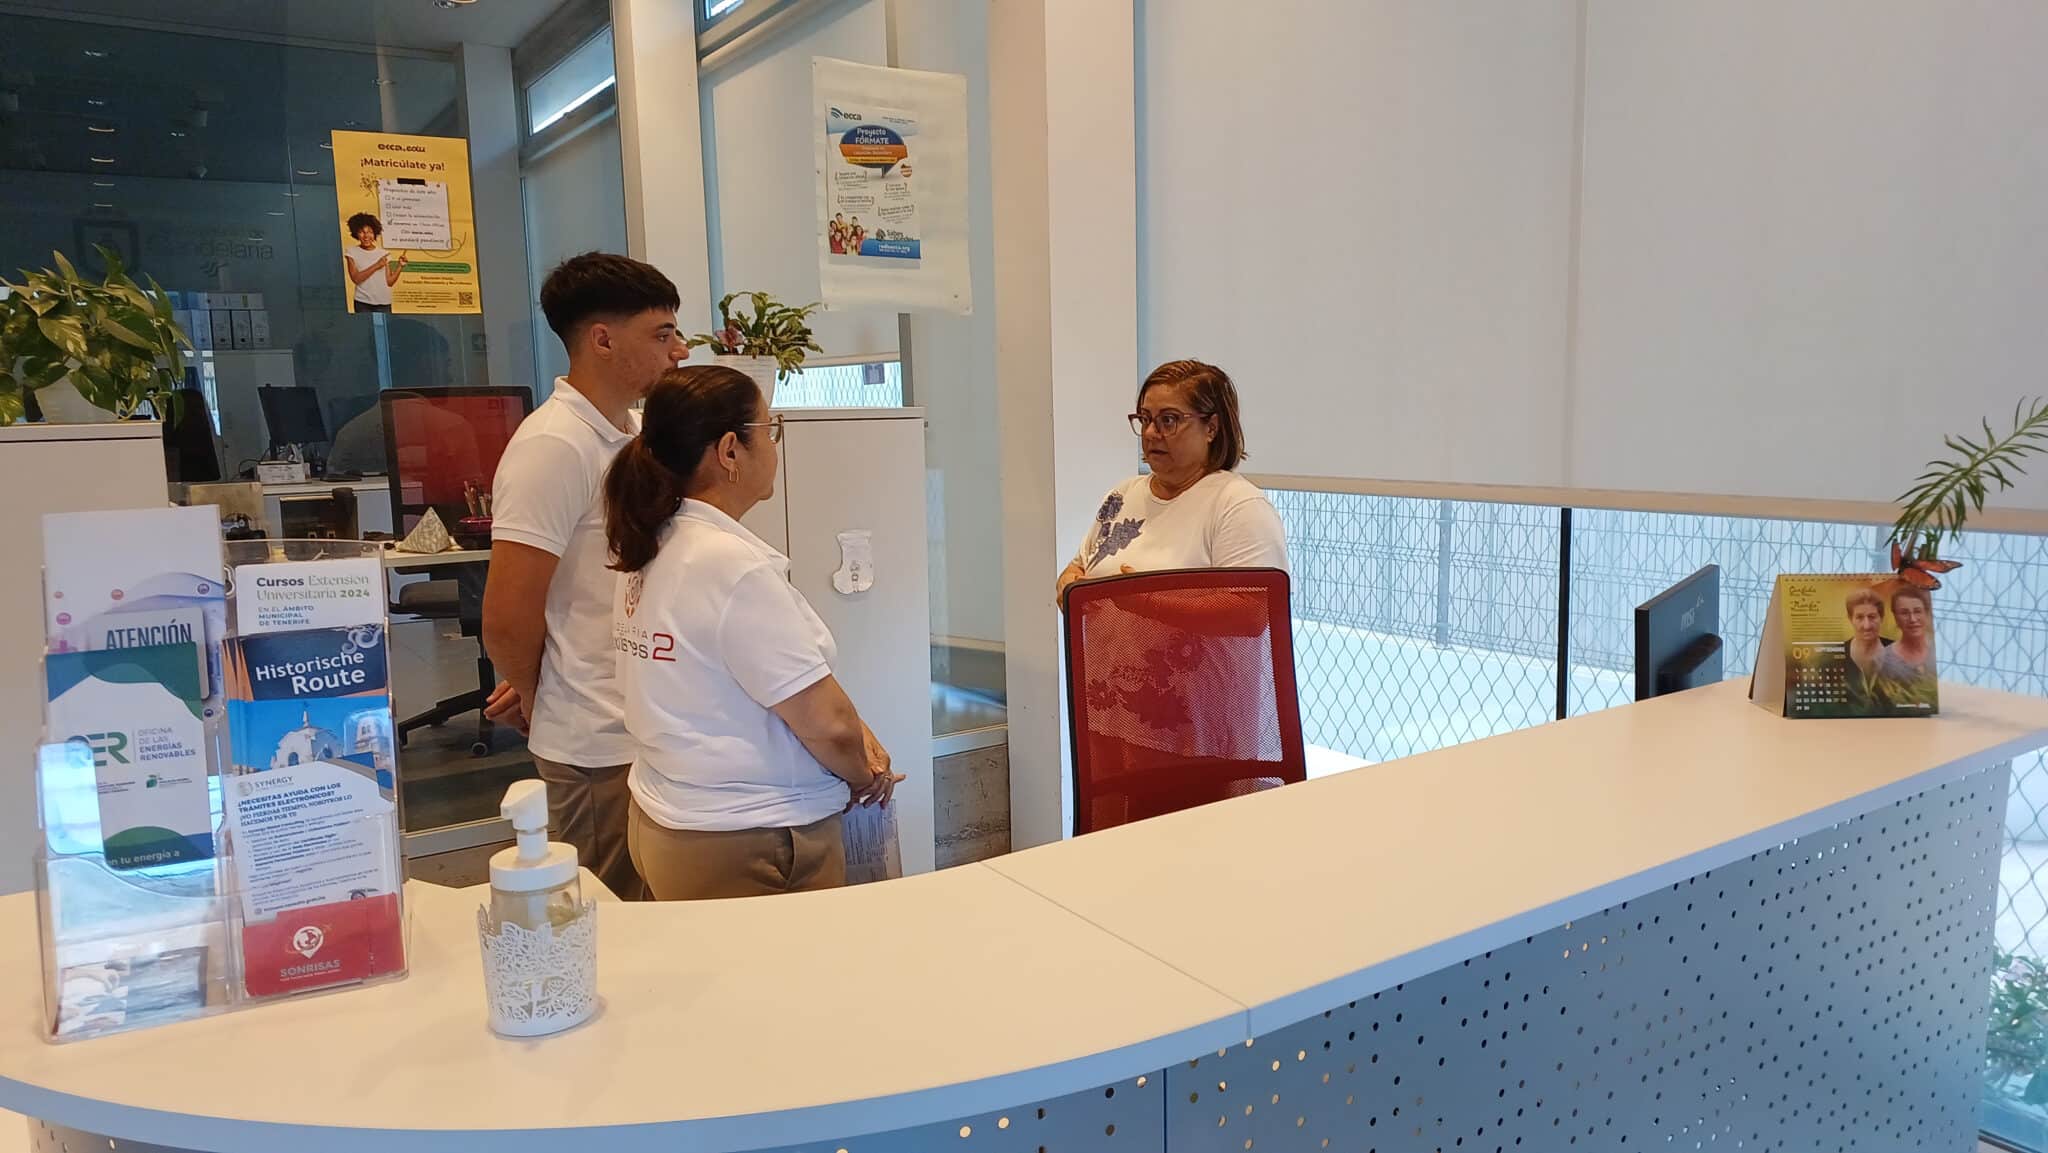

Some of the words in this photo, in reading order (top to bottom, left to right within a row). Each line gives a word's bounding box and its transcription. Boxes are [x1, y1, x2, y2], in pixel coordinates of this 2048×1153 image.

[843, 112, 862, 121] ecca
[856, 127, 887, 137] Proyecto
[360, 157, 427, 170] ¡Matricúlate
[429, 162, 446, 172] ya!
[256, 576, 304, 587] Cursos
[256, 589, 337, 601] Universitaria
[339, 588, 370, 598] 2024
[258, 612, 304, 620] MUNICIPAL
[106, 619, 193, 650] ATENCIÓN
[255, 651, 365, 681] Historische
[291, 668, 366, 695] Route
[138, 727, 173, 737] OFICINA
[139, 737, 150, 745] DE
[152, 735, 169, 743] LAS
[140, 749, 196, 761] RENOVABLES
[254, 775, 294, 789] SYNERGY
[283, 788, 309, 799] AYUDA
[310, 784, 326, 794] CON
[327, 782, 342, 790] LOS
[120, 856, 131, 865] tu
[173, 849, 181, 857] a
[279, 959, 341, 978] SONRISAS
